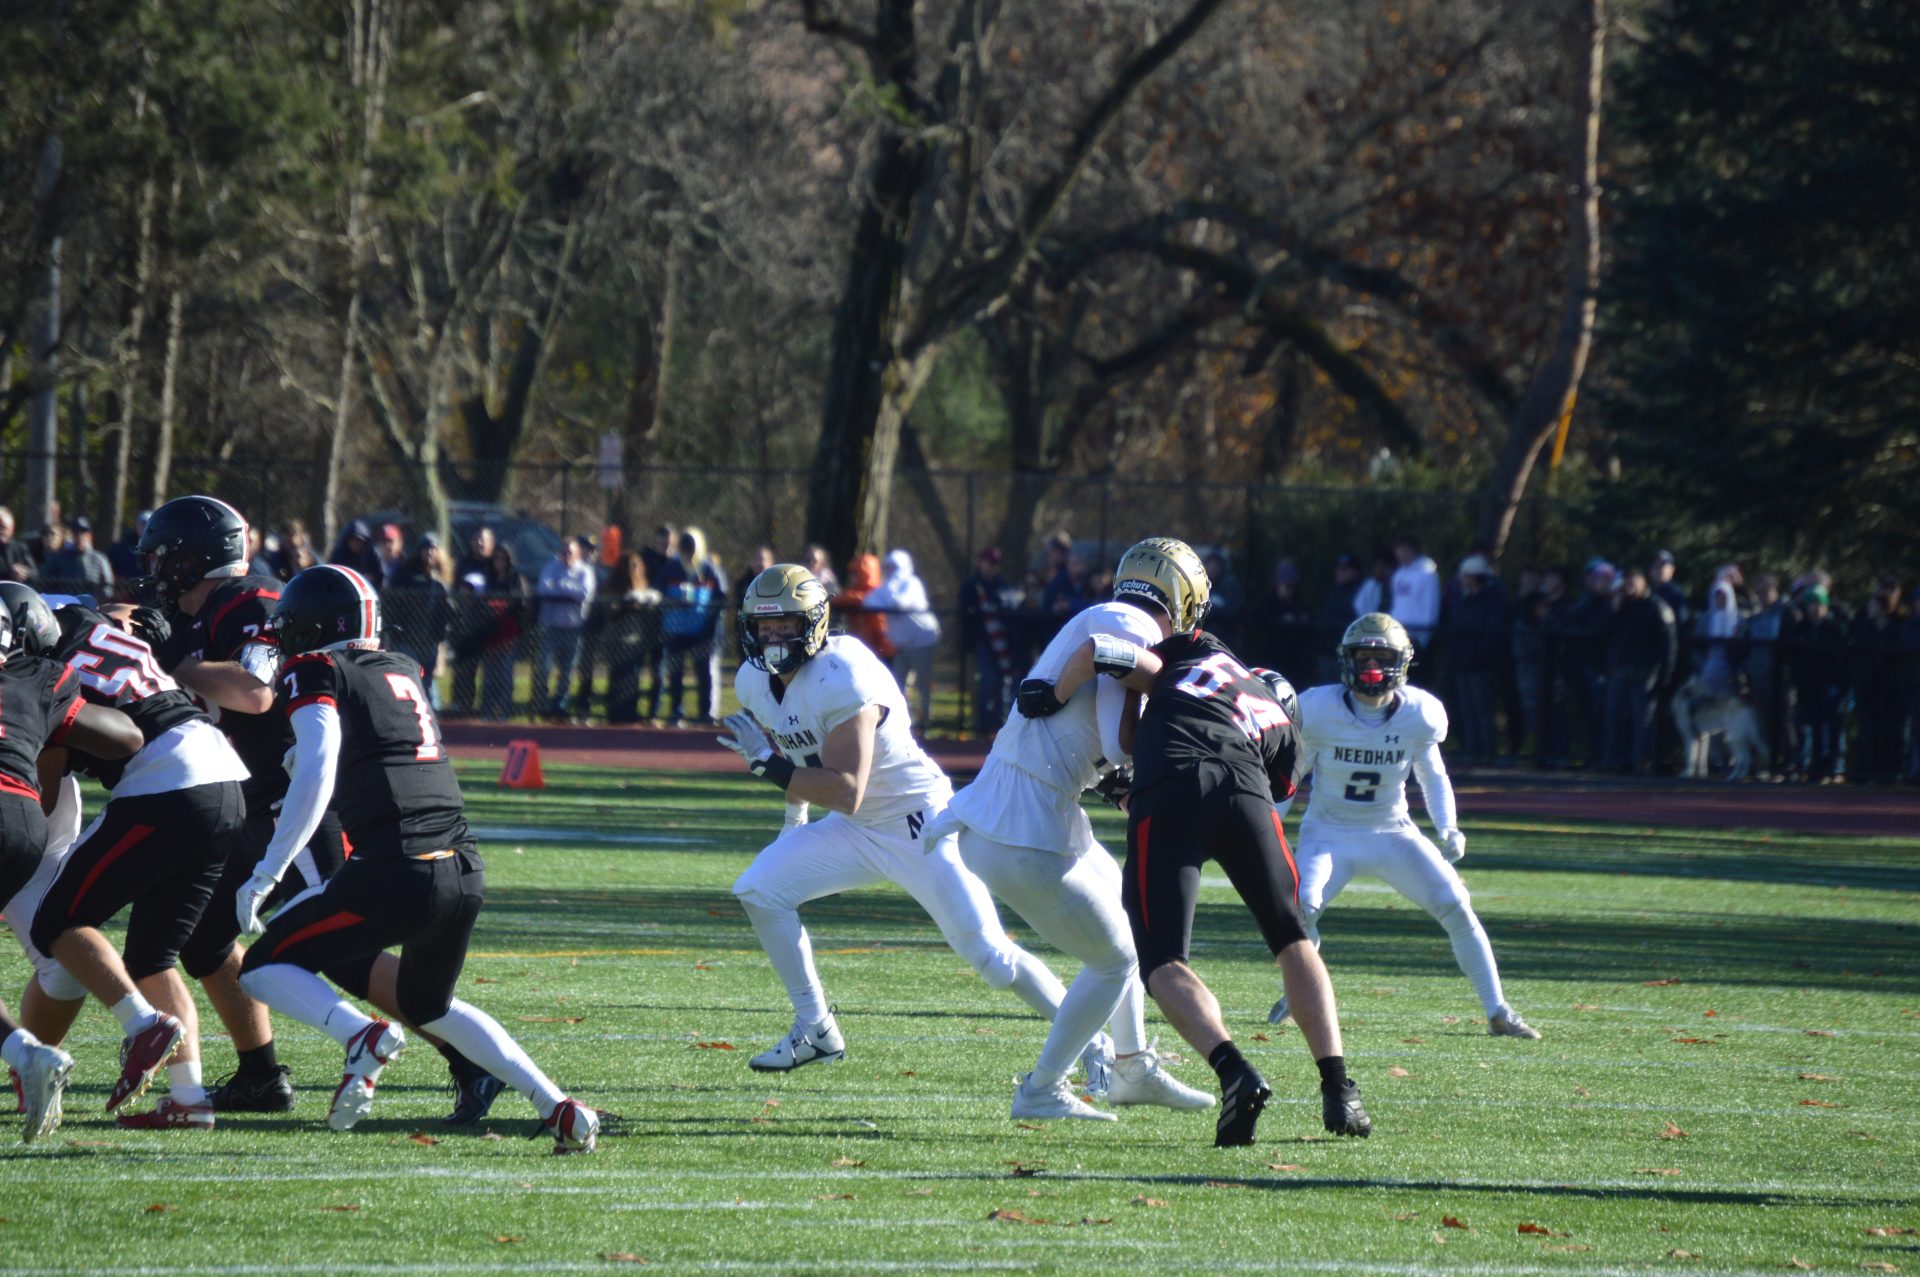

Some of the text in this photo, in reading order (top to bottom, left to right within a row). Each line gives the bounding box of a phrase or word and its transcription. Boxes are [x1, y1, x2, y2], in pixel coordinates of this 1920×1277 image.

[1122, 580, 1150, 591] schutt
[65, 622, 180, 703] 50
[283, 671, 300, 699] 7
[384, 672, 440, 760] 7
[1175, 652, 1291, 741] 64
[1344, 771, 1381, 802] 2
